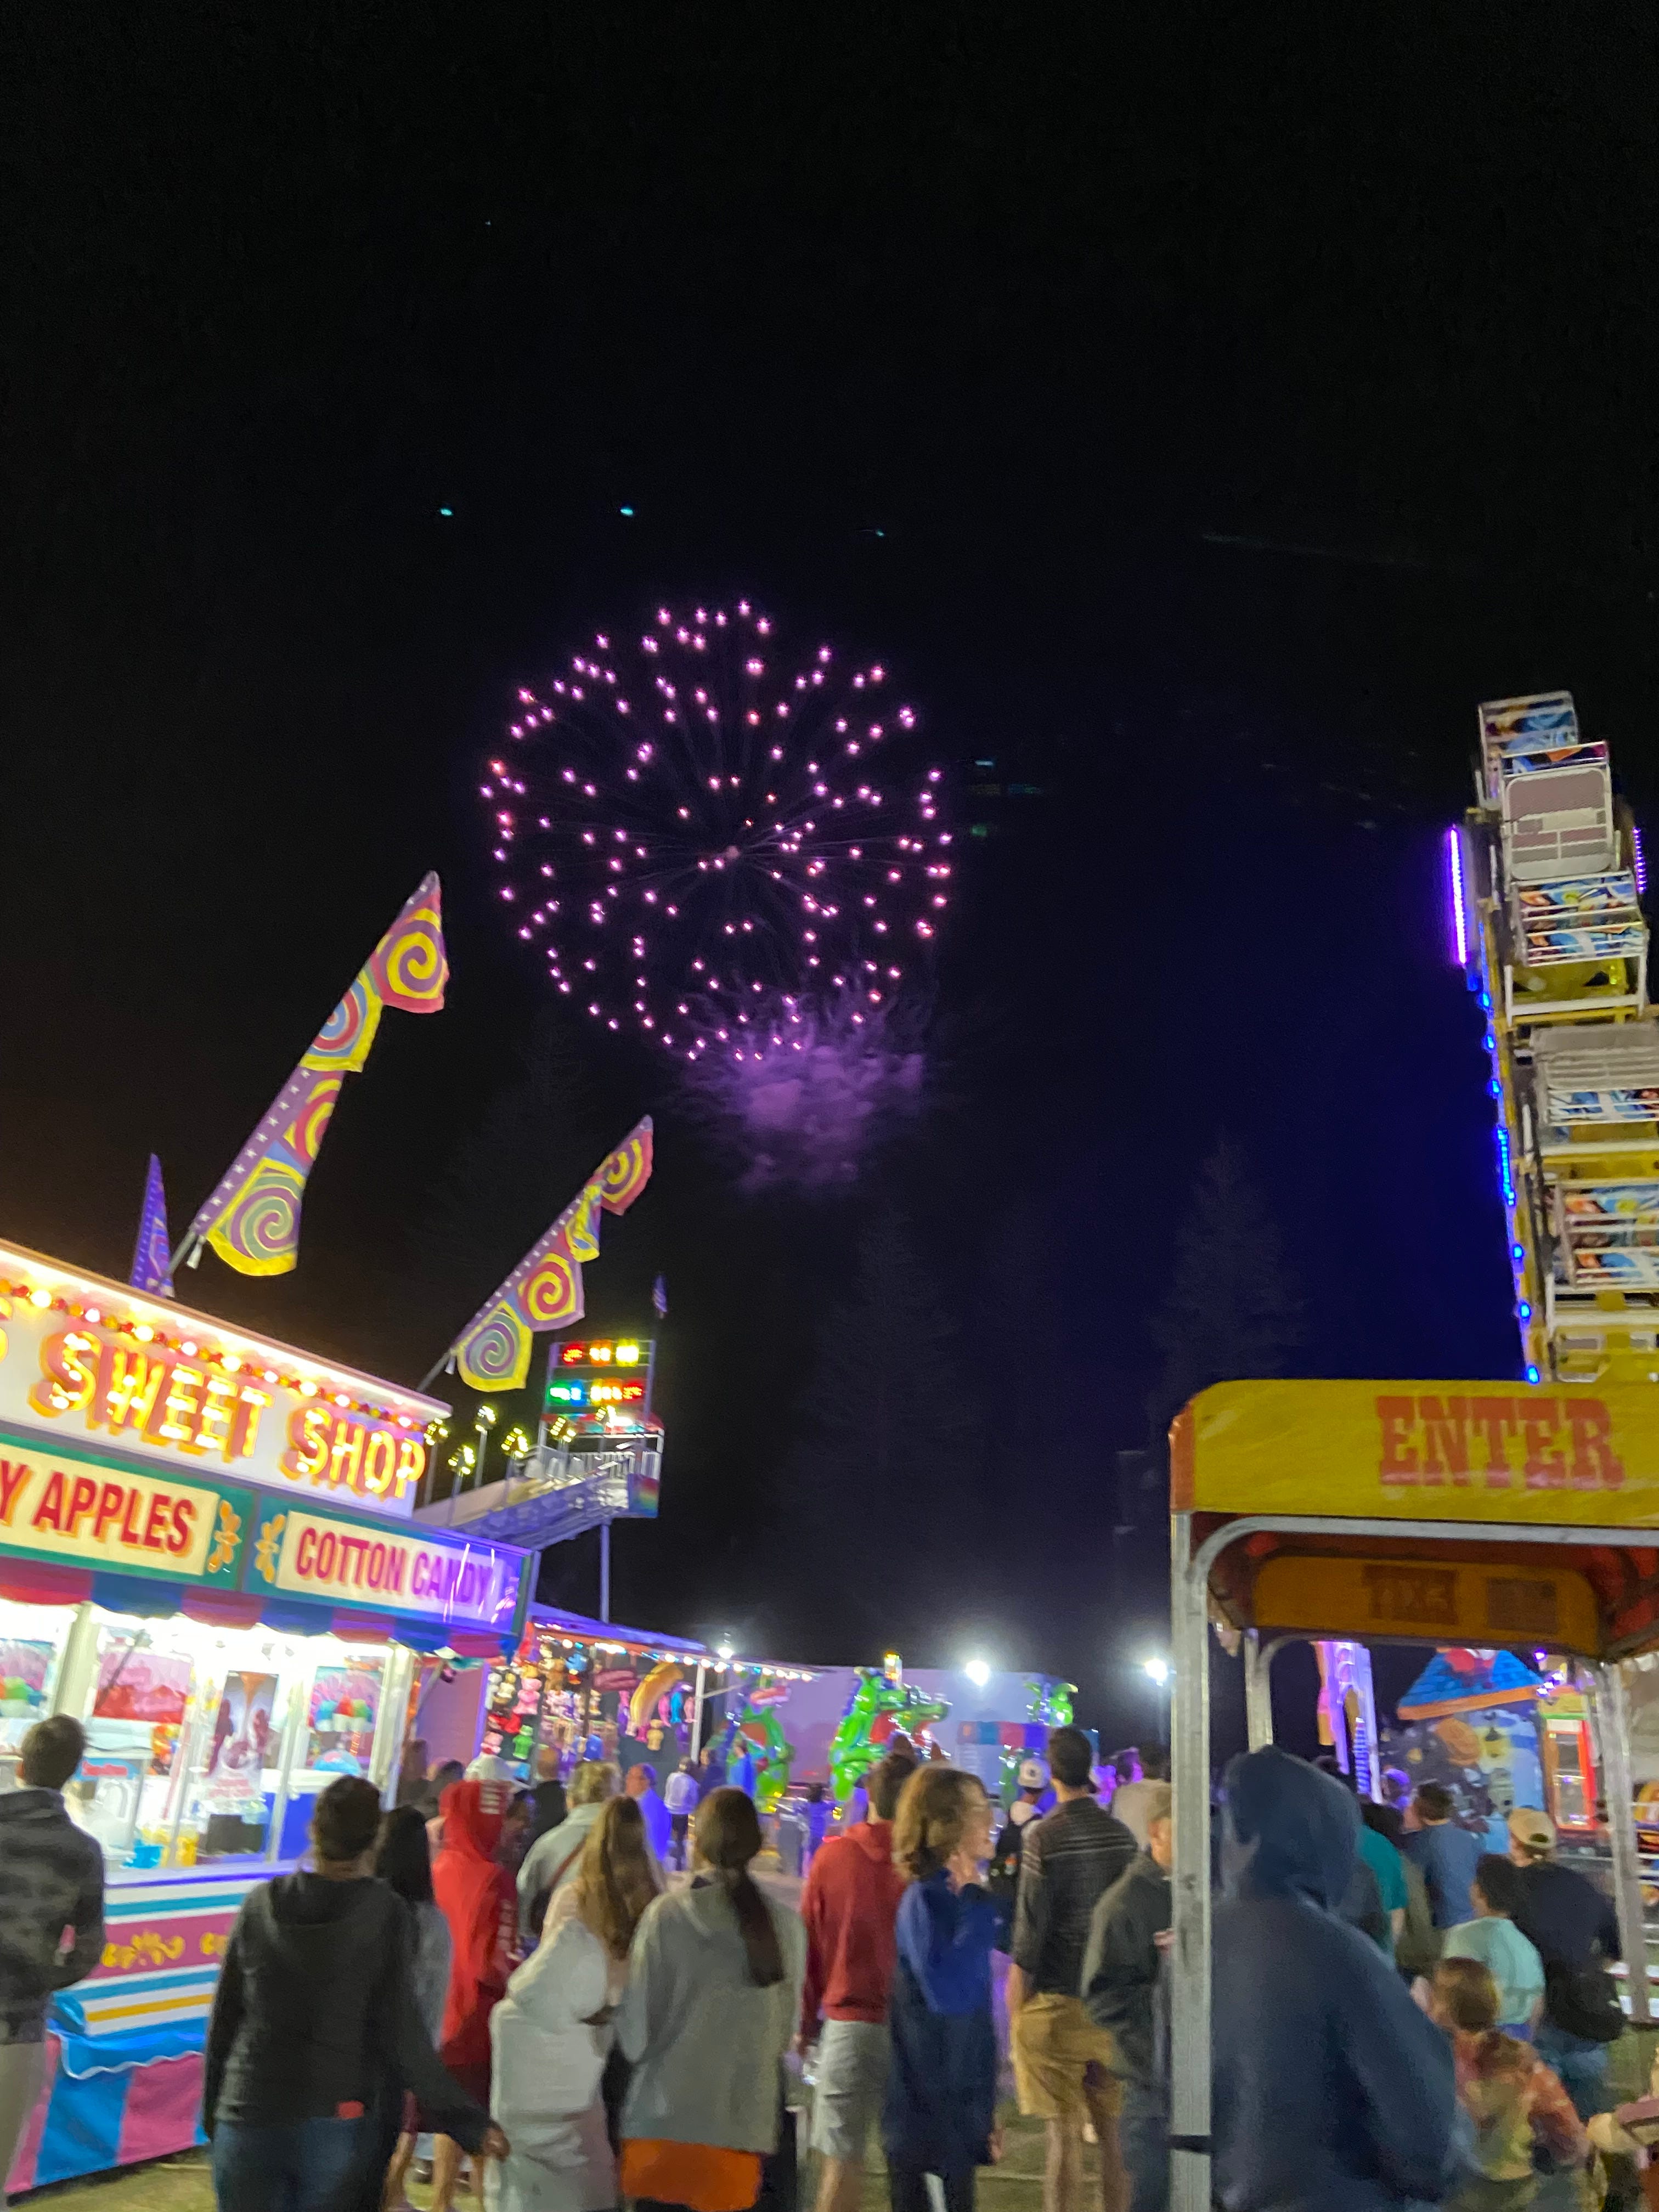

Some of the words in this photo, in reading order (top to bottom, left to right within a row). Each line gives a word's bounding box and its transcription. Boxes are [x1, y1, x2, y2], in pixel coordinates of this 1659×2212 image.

[29, 1330, 275, 1463] SWEET
[280, 1406, 426, 1500] SHOP
[1376, 1396, 1625, 1490] ENTER
[32, 1471, 196, 1557] APPLES
[296, 1527, 407, 1594] COTTON
[411, 1551, 494, 1607] CANDY
